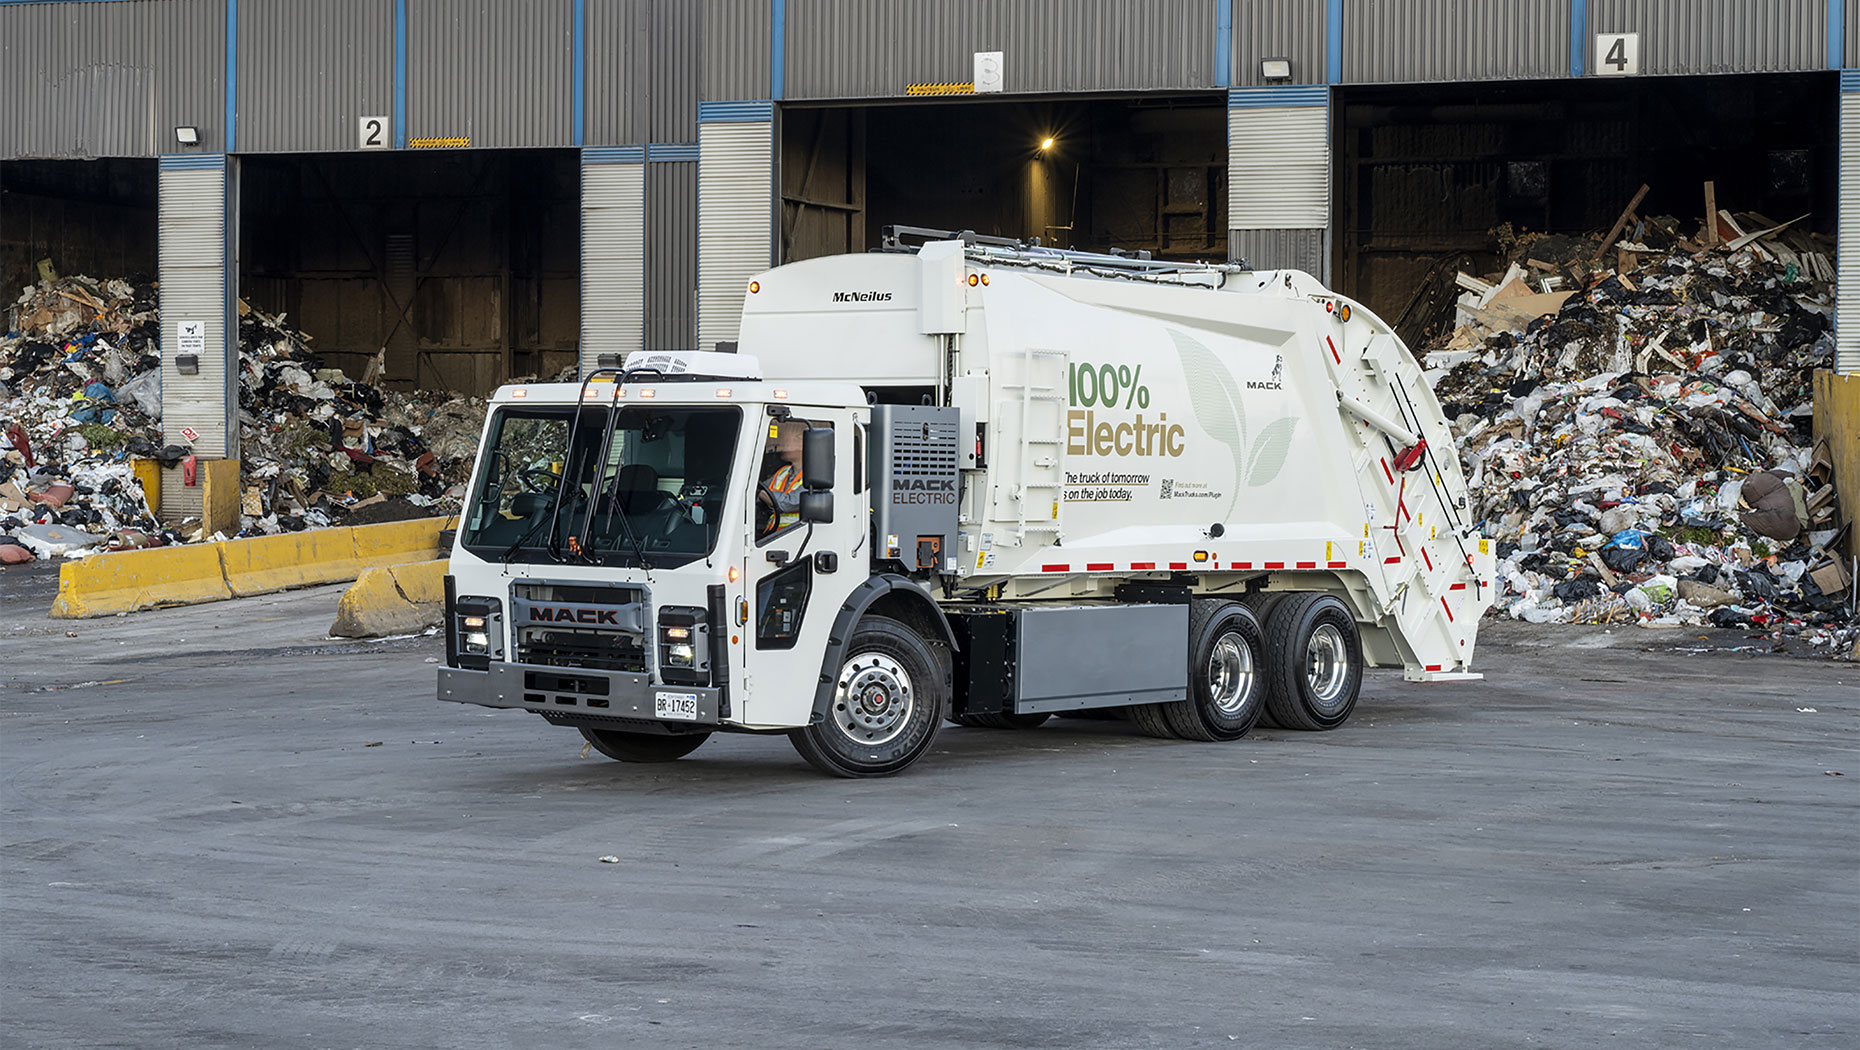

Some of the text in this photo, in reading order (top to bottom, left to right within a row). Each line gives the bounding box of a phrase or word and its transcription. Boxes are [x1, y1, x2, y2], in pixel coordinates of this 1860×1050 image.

[1605, 38, 1628, 71] 4
[366, 120, 381, 146] 2
[832, 291, 893, 302] McNeilus
[1068, 362, 1150, 410] 100%
[1246, 381, 1283, 390] MACK
[1067, 410, 1185, 457] Electric
[1079, 471, 1101, 484] truck
[1101, 471, 1111, 484] of
[1111, 471, 1150, 484] tomorrow
[892, 479, 956, 491] MACK
[892, 492, 956, 505] ELECTRIC
[1068, 490, 1080, 500] on
[1080, 488, 1094, 499] the
[1094, 488, 1108, 501] job
[1109, 488, 1133, 501] today.
[529, 606, 620, 625] MACK
